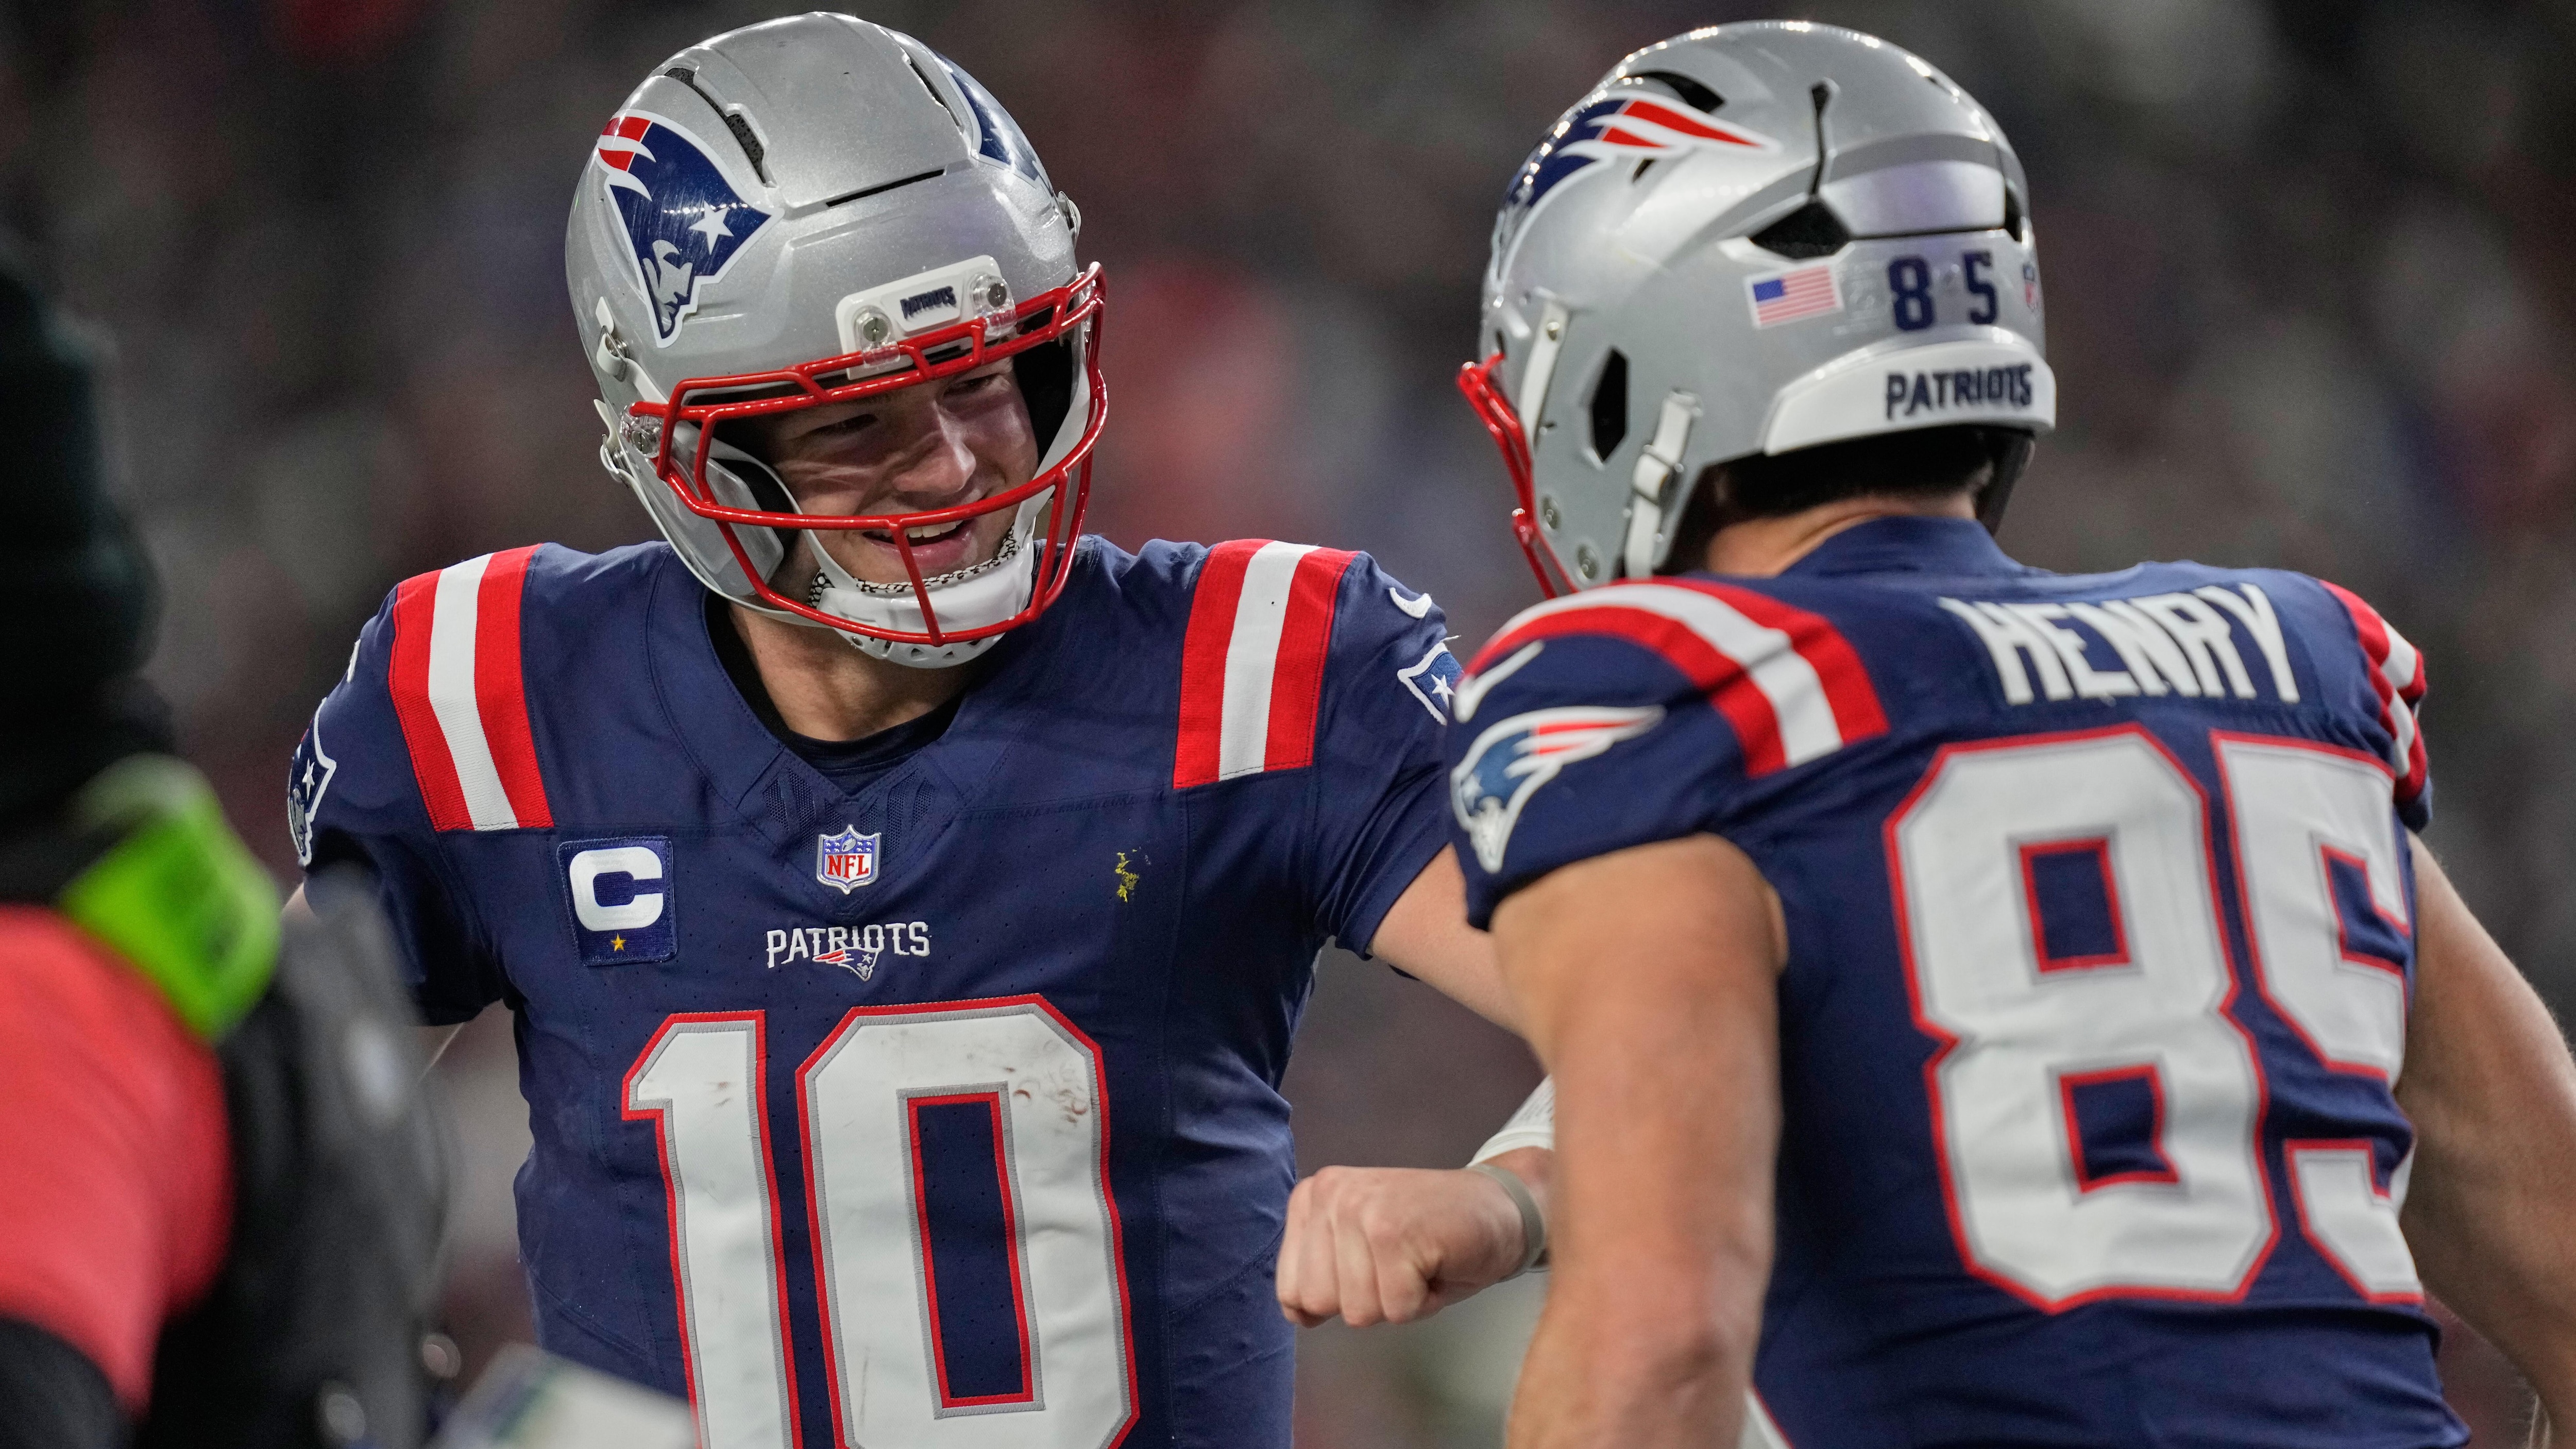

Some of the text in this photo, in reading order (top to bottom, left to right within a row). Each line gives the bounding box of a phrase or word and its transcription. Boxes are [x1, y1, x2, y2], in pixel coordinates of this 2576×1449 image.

[1885, 364, 2033, 422] PATRIOTS
[1938, 582, 2300, 705] HENRY
[569, 846, 664, 932] C
[827, 854, 870, 880] NFL
[766, 921, 930, 969] PATRIOTS
[1883, 721, 2426, 1315] 85
[622, 993, 1140, 1449] 10
